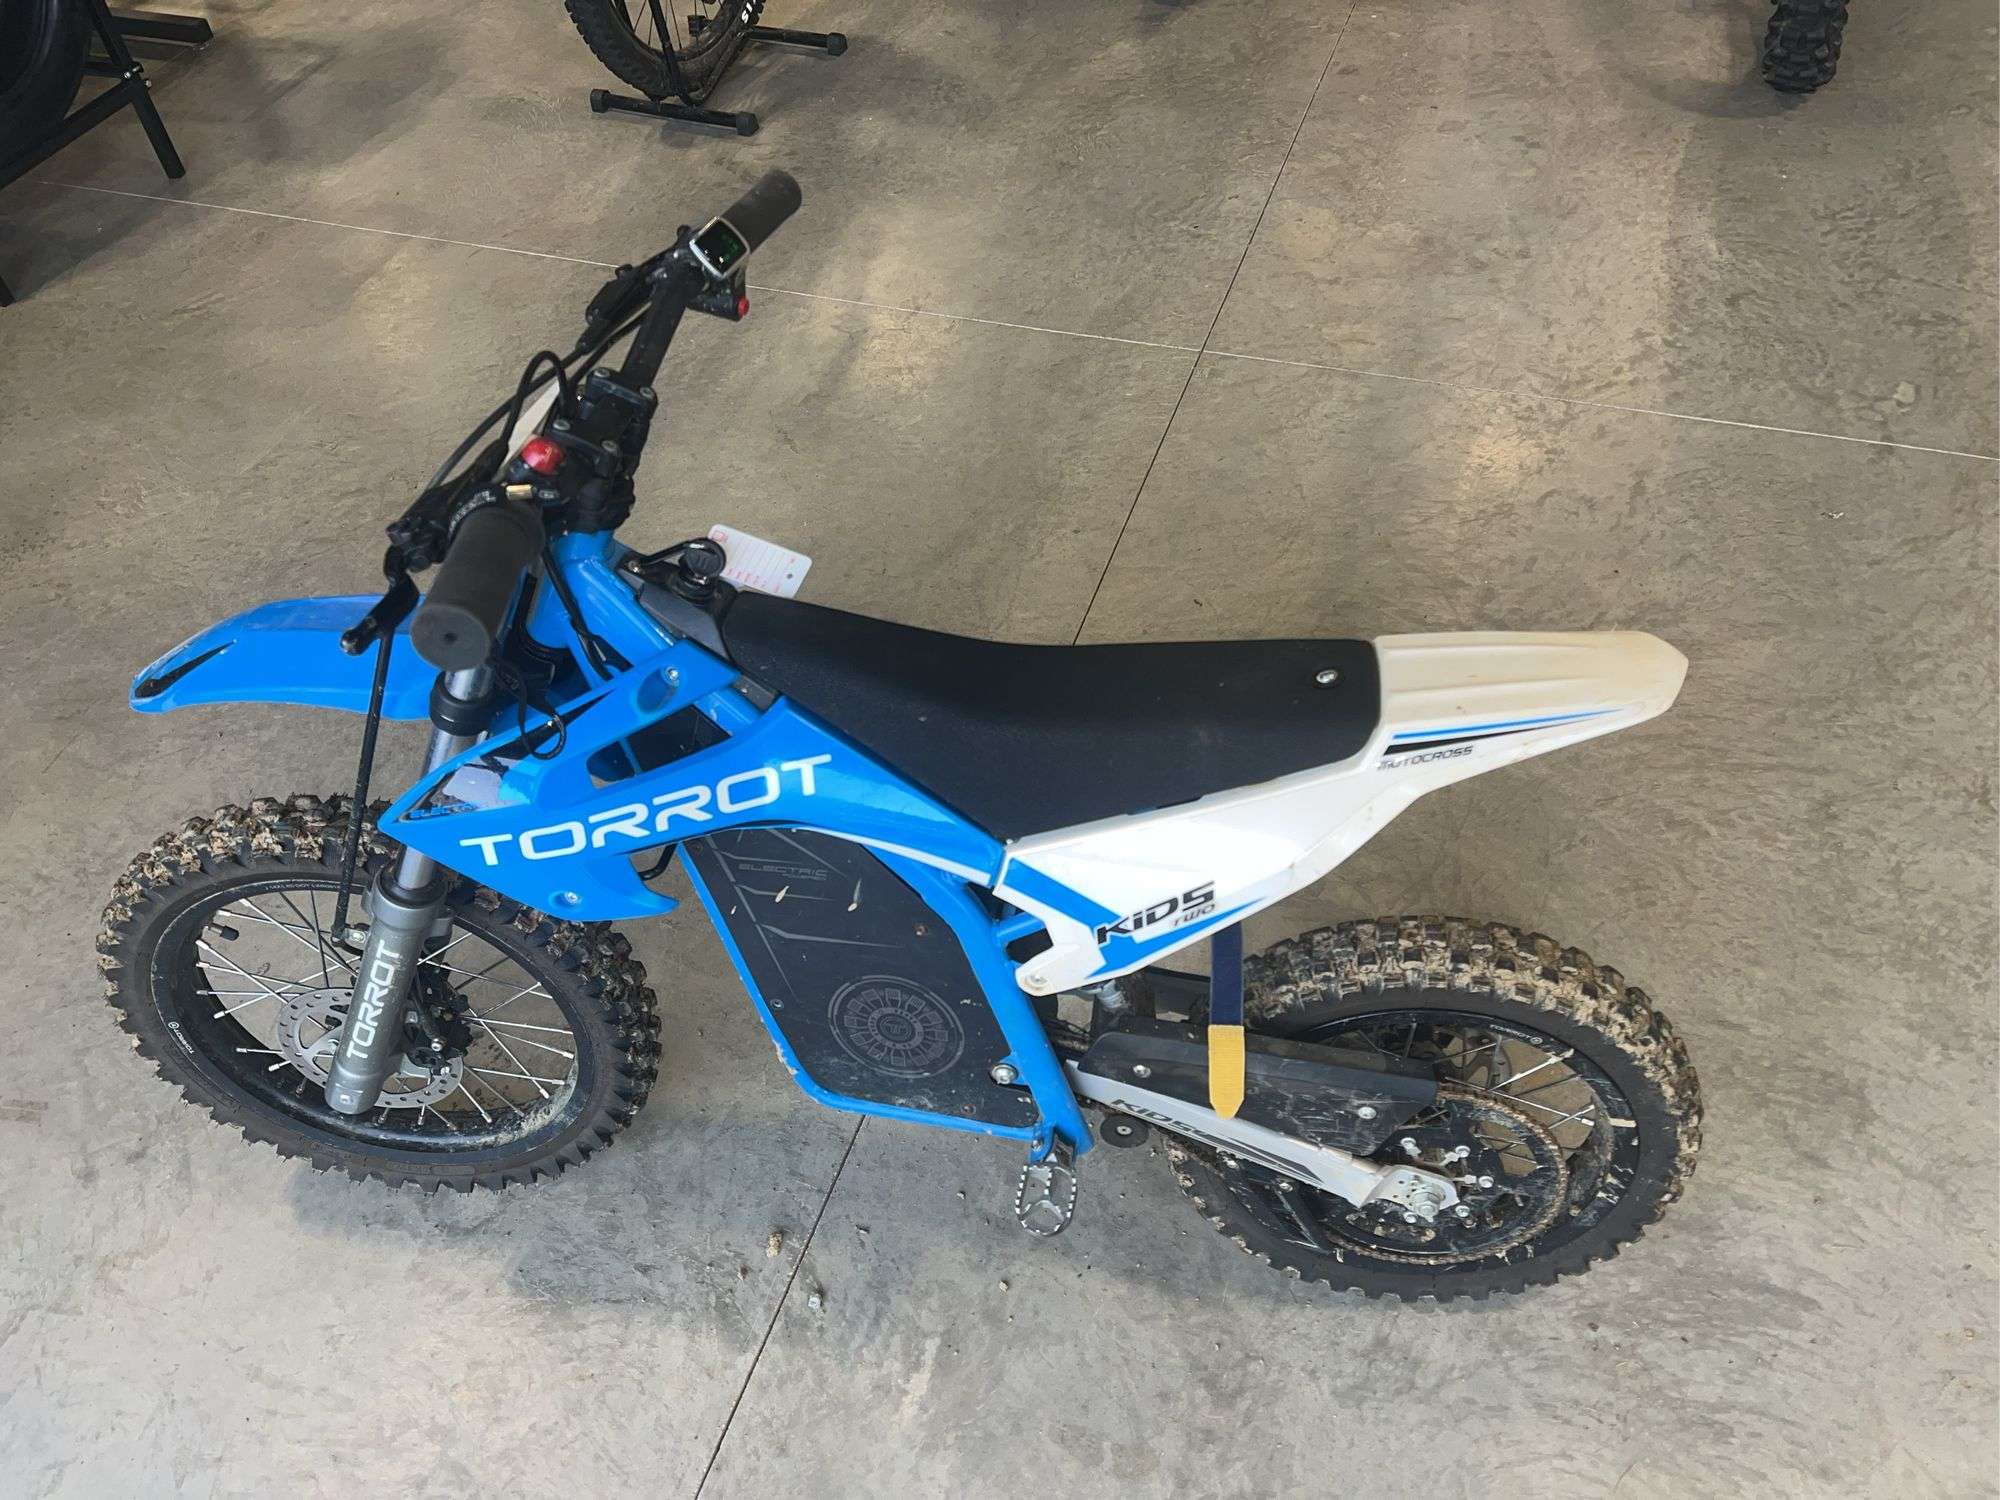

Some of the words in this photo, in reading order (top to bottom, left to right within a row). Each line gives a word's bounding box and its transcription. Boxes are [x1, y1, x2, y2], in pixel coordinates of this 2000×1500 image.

[459, 754, 832, 866] TORROT
[738, 863, 828, 877] ELECTRIC
[346, 939, 401, 1059] TORROT
